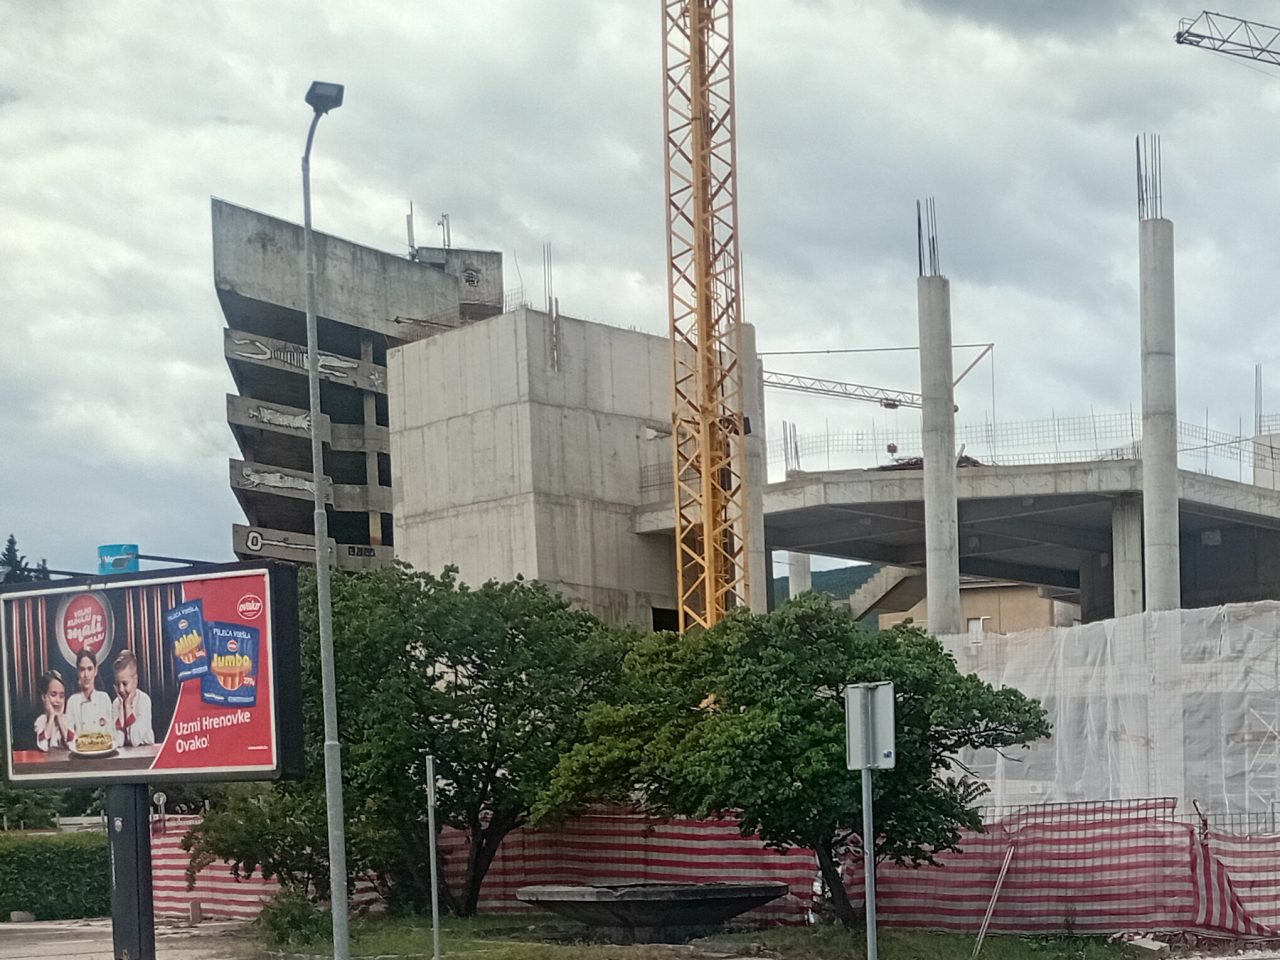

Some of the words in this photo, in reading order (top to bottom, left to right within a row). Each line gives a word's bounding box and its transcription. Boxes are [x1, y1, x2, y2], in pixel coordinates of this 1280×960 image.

[175, 717, 201, 736] Uzmi
[202, 709, 251, 730] Hrenovke
[176, 734, 210, 753] Ovako!
